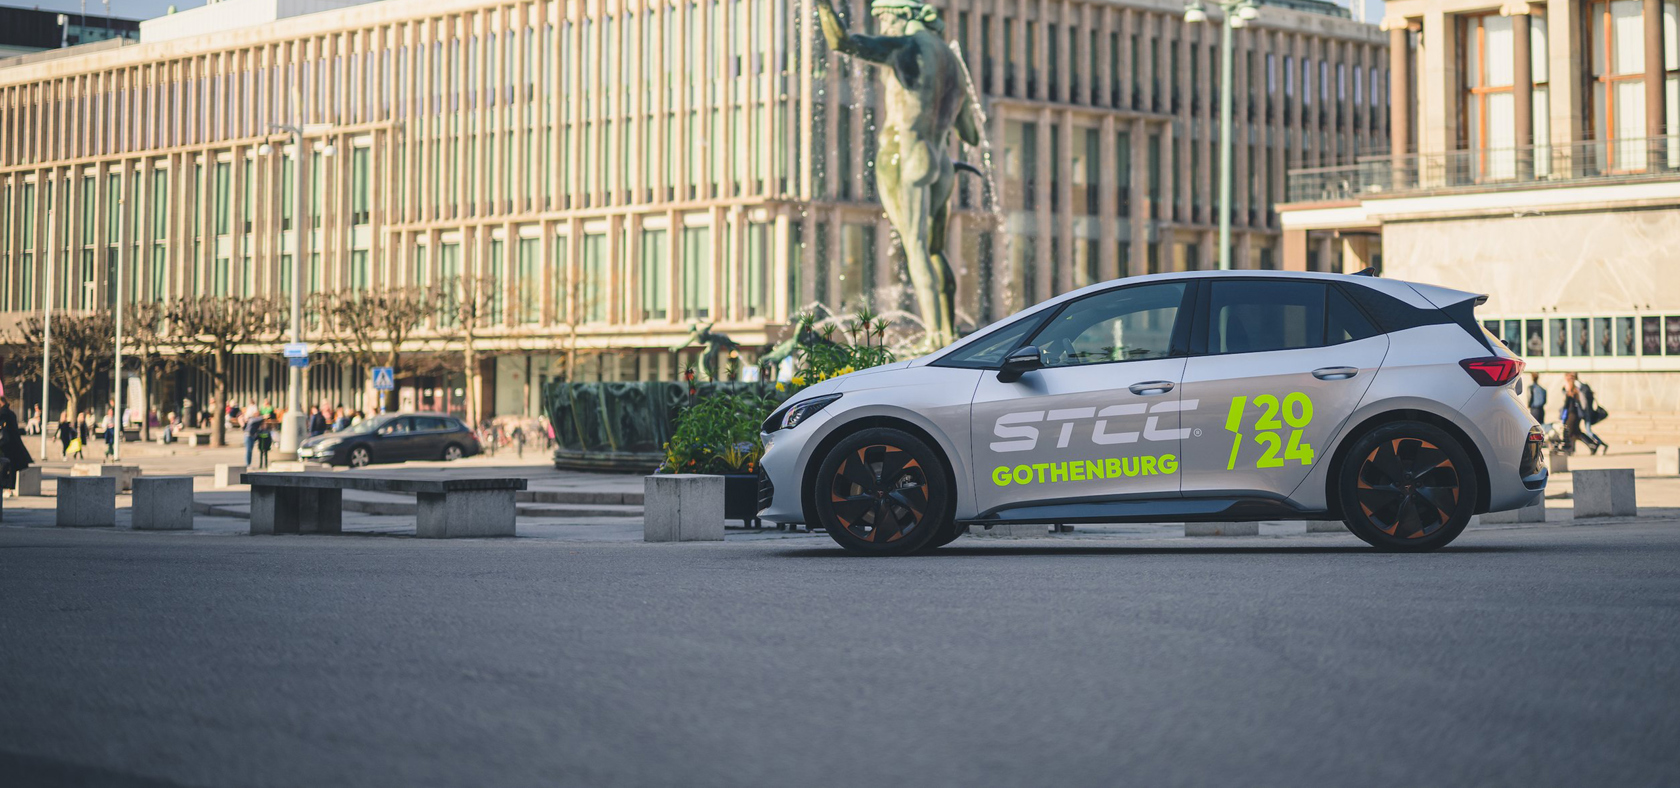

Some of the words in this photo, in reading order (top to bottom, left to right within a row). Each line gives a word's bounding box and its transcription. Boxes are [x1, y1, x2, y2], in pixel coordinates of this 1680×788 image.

[990, 399, 1199, 452] STCC
[1252, 391, 1314, 431] 20
[1254, 429, 1315, 469] 24
[991, 453, 1179, 487] GOTHENBURG
